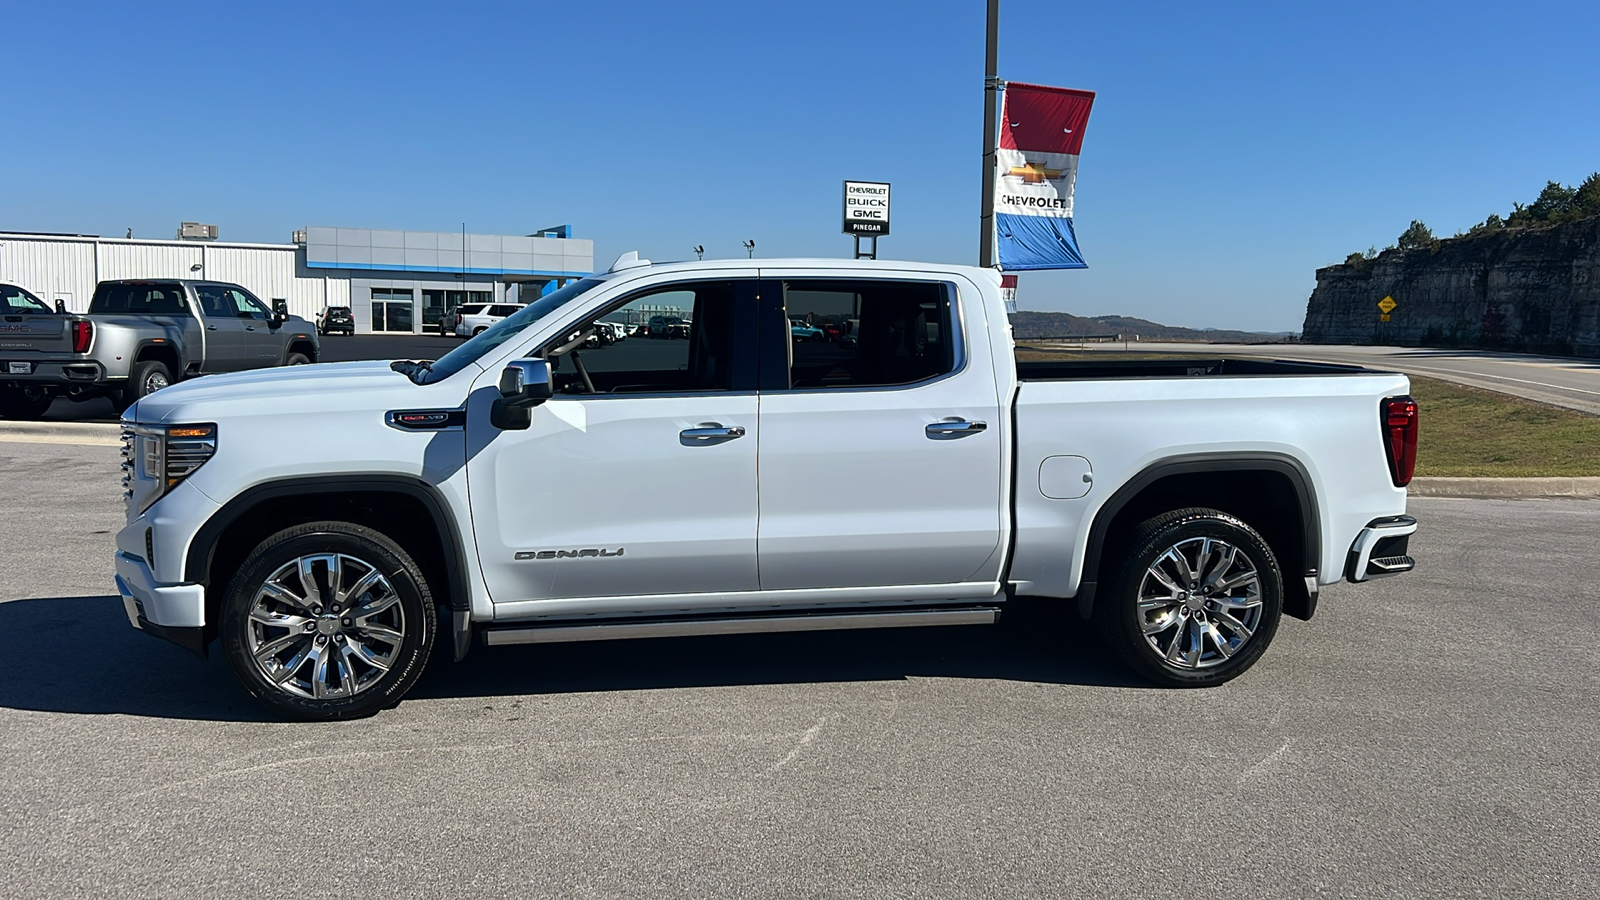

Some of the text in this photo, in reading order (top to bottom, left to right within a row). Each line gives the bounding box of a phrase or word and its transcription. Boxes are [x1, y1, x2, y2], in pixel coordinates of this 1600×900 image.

[849, 186, 886, 195] CHEVROLET
[848, 198, 886, 207] BUICK
[1002, 195, 1066, 209] CHEVROLET
[853, 210, 881, 218] GMC
[514, 547, 624, 560] DENALI
